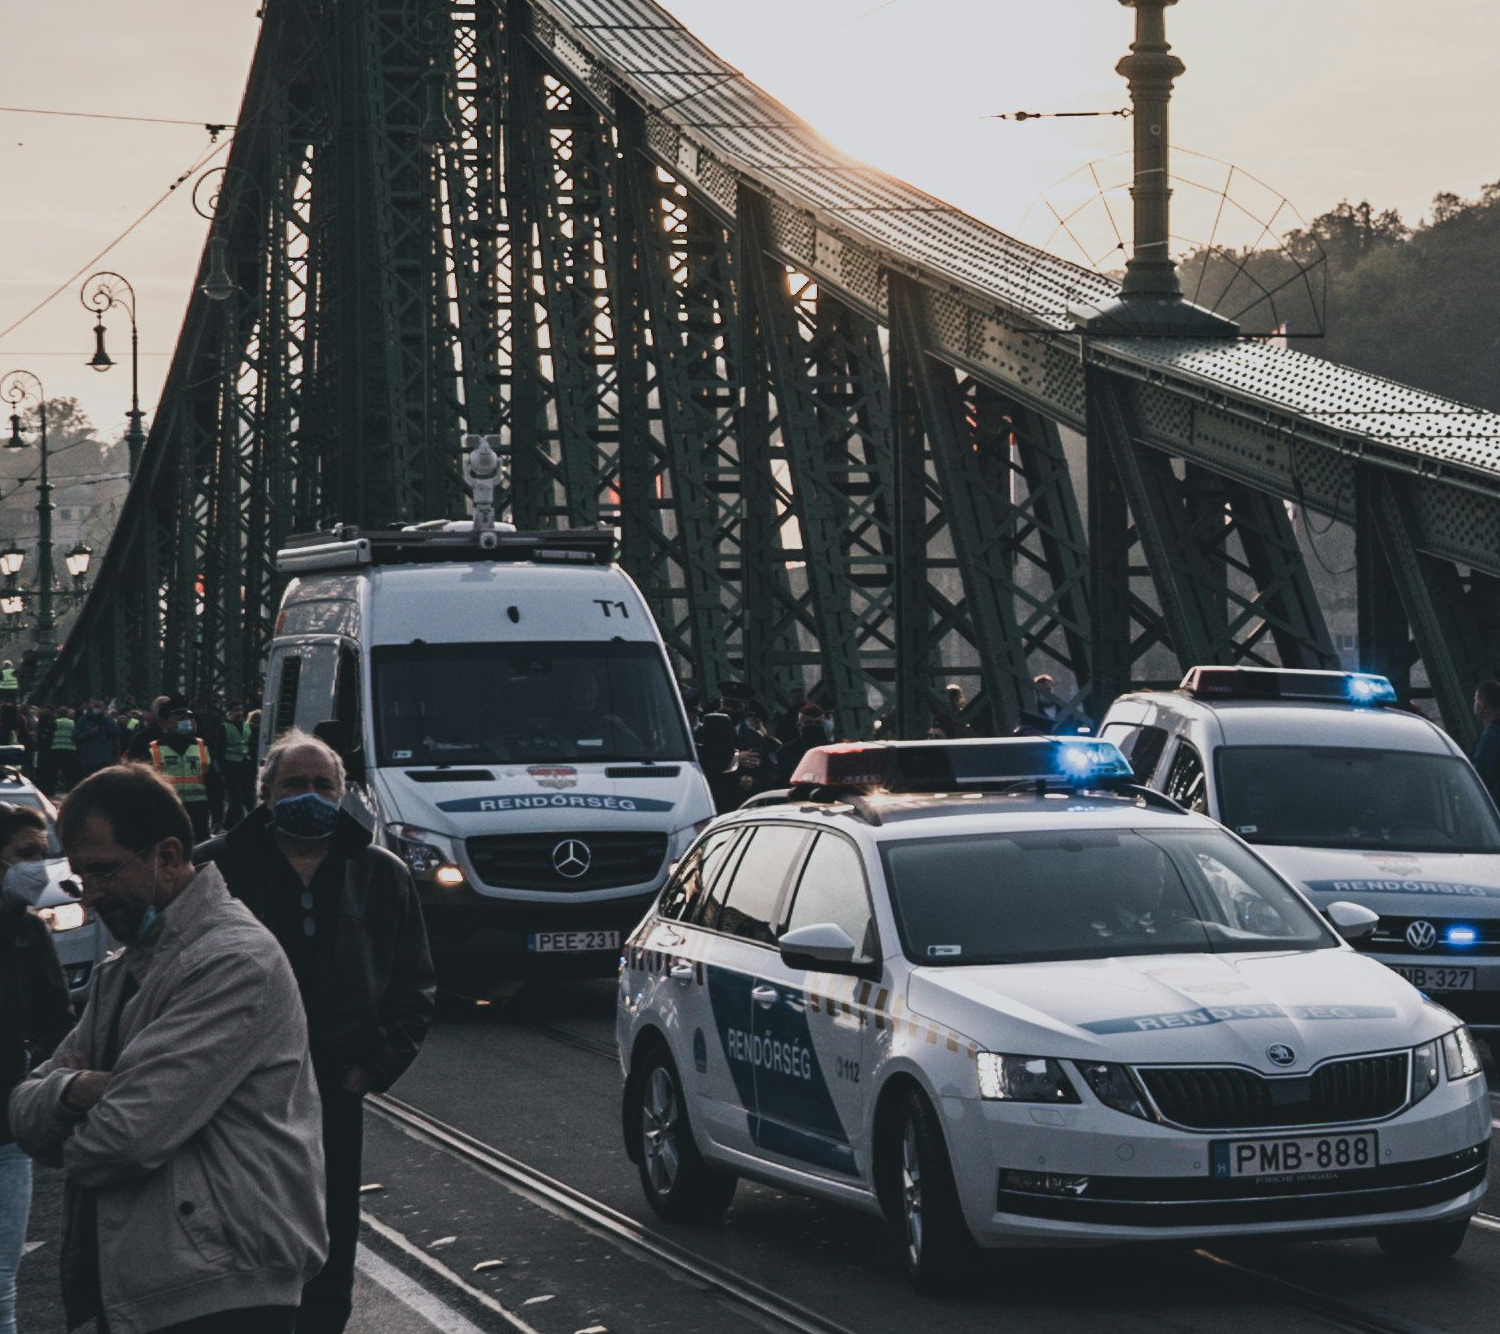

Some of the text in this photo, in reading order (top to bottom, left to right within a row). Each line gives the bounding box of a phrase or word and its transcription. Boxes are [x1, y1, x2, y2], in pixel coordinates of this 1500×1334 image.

[592, 599, 629, 618] T1
[479, 794, 637, 812] RENDŐRSÉG
[540, 932, 616, 949] PEE-231
[1398, 969, 1470, 988] NB-327
[728, 1028, 860, 1083] RENDŐRSÉG 112
[1237, 1137, 1369, 1174] PMB-888
